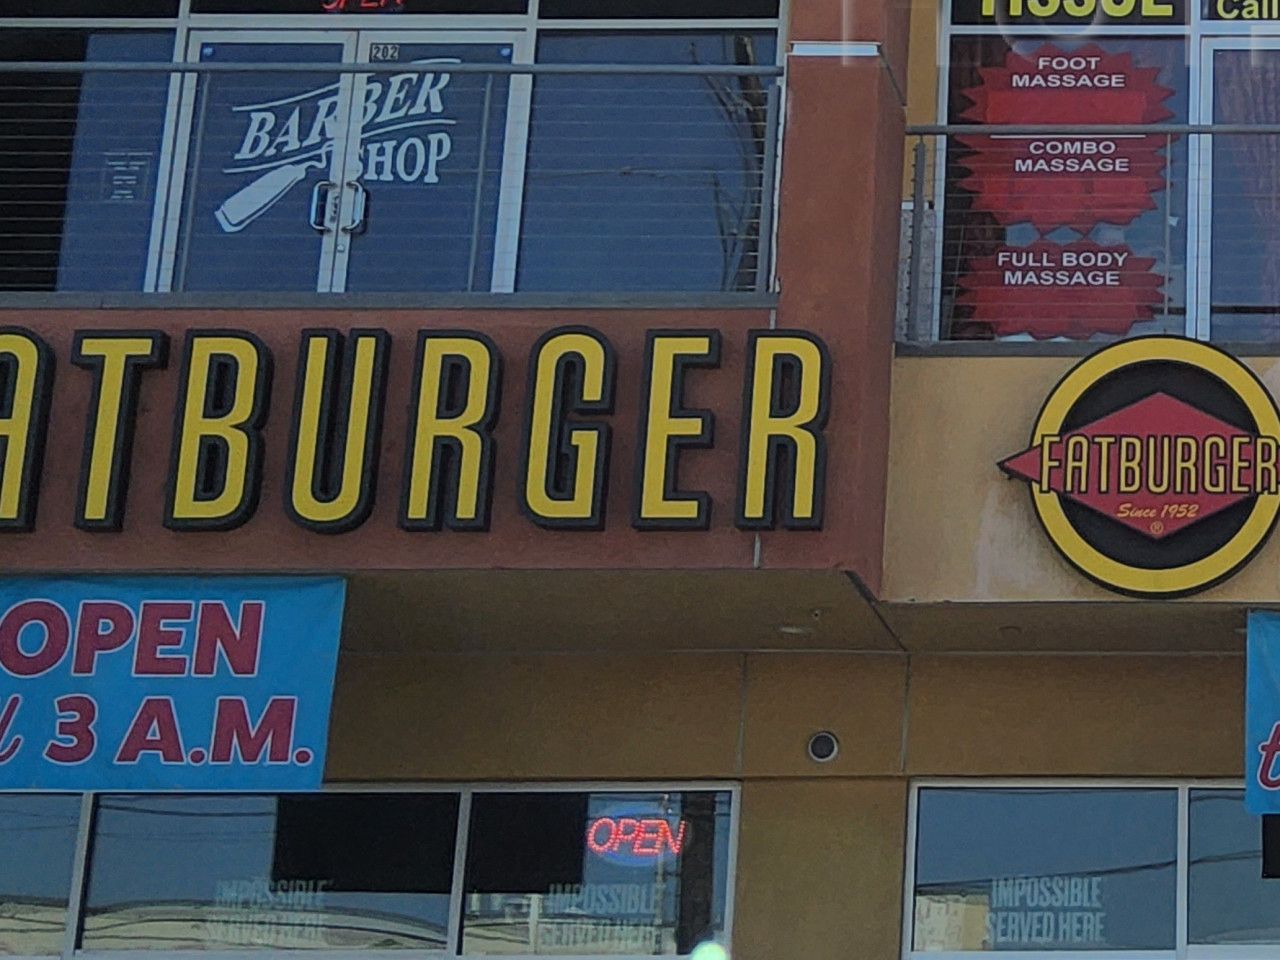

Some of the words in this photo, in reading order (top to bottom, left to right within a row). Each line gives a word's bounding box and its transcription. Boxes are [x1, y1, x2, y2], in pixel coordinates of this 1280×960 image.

[373, 43, 399, 61] 202
[1038, 57, 1101, 70] FOOT
[1012, 74, 1126, 88] MASSAGE
[1029, 141, 1116, 155] COMBO
[345, 132, 451, 184] HOP
[1015, 158, 1130, 172] MASSAGE
[998, 252, 1055, 267] FULL
[1062, 252, 1128, 267] BODY
[1004, 271, 1120, 286] MASSAGE
[1039, 435, 1279, 494] FATBURGER
[1117, 503, 1156, 518] Since
[1160, 503, 1200, 517] 1952
[0, 599, 265, 677] OPEN
[44, 693, 97, 766] 3
[114, 695, 314, 766] A.M.
[587, 816, 688, 856] OPEN
[991, 877, 1102, 908] IMPOSSIBLE
[985, 912, 1054, 943] SERVED
[1058, 912, 1106, 943] HERE
